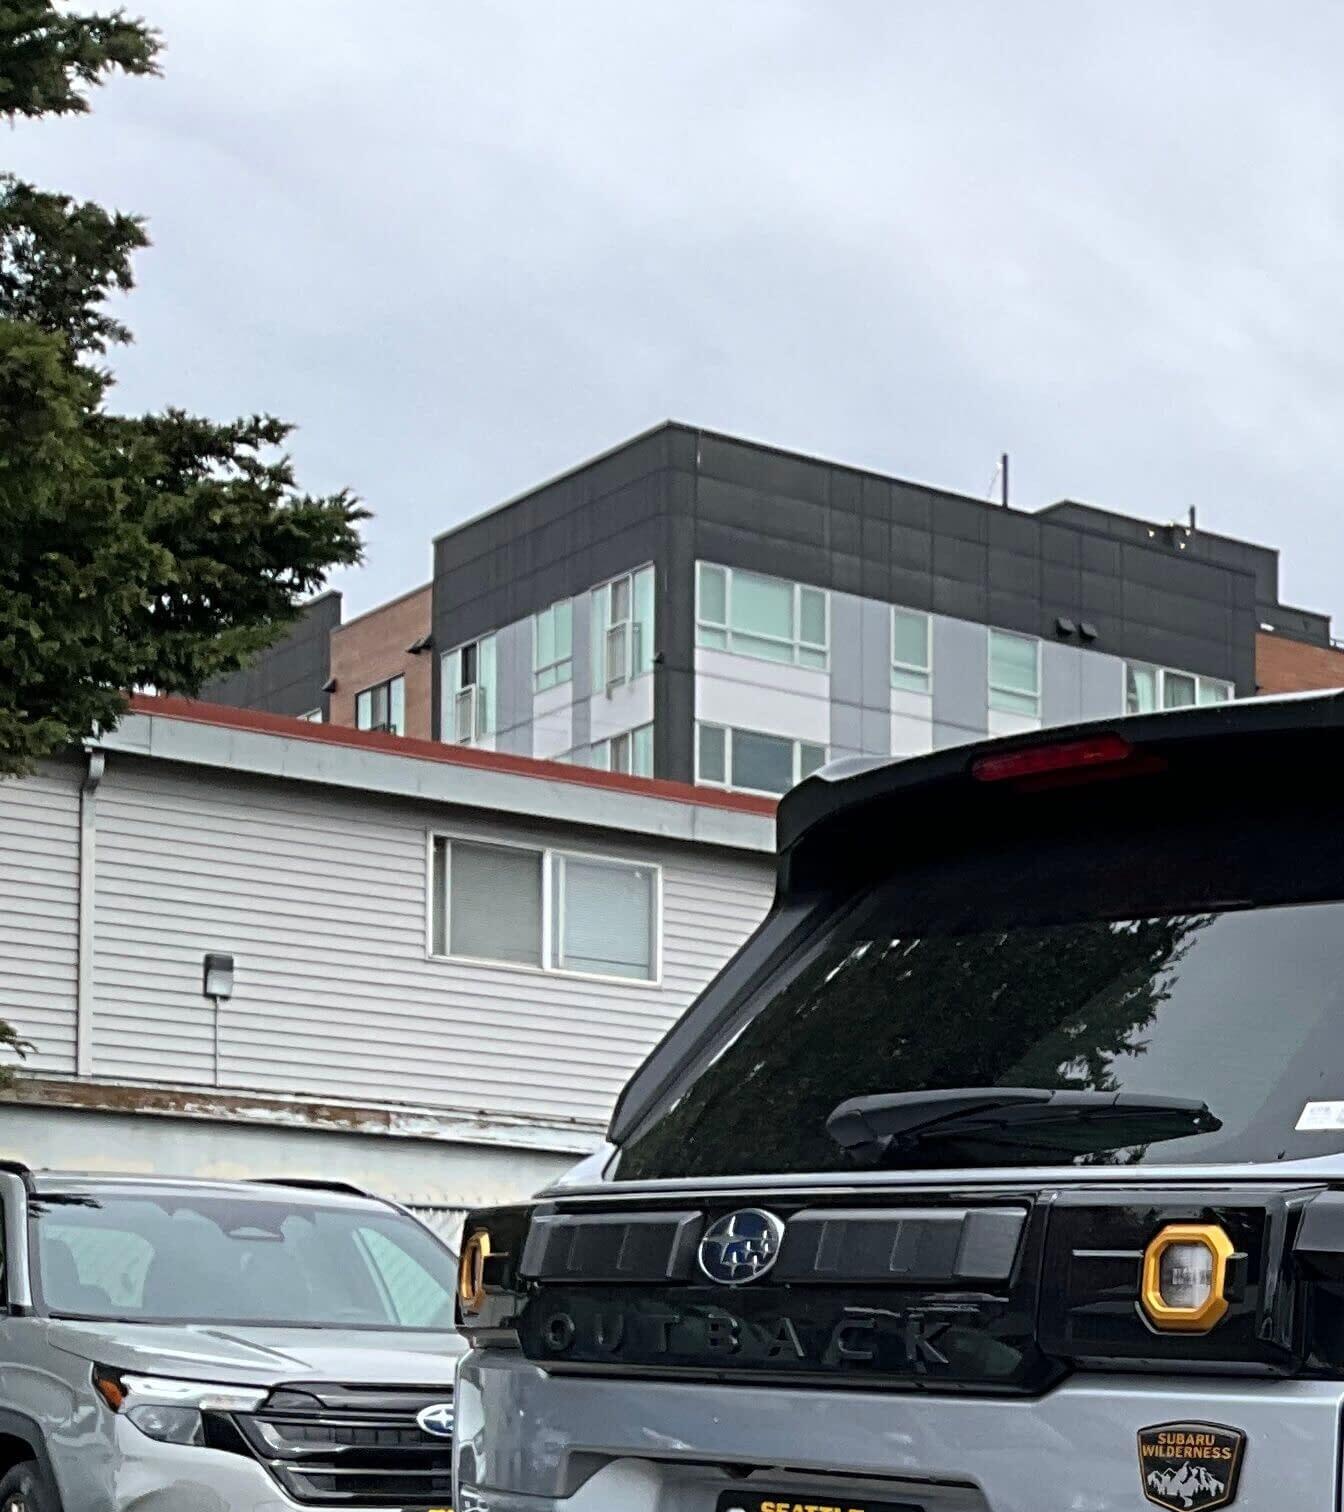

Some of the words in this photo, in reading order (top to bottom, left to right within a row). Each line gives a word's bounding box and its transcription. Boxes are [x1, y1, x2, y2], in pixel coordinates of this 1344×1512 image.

[542, 1308, 952, 1366] OUTBACK
[1158, 1432, 1216, 1446] SUBARU
[1142, 1444, 1232, 1460] WILDERNESS
